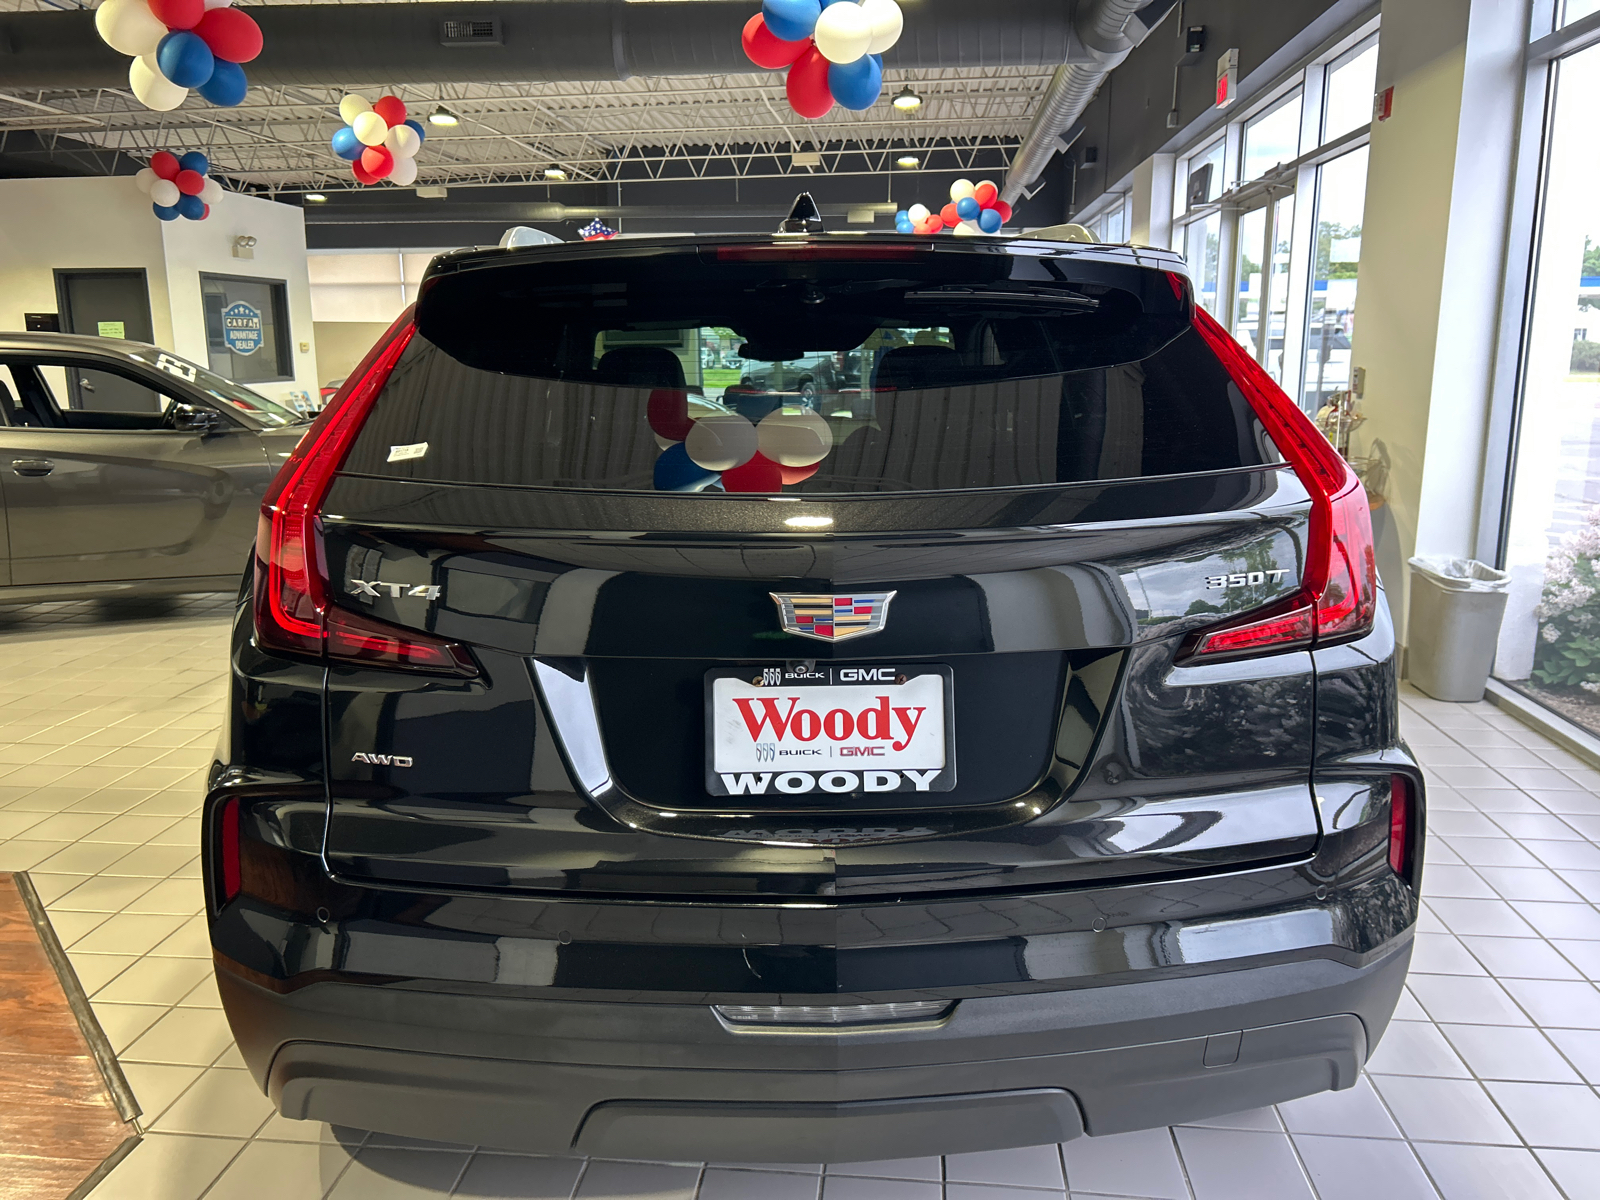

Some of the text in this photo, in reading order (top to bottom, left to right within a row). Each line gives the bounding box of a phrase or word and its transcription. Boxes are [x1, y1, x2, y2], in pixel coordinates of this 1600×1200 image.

[226, 318, 260, 329] CARFAX
[230, 330, 259, 340] ADVANTAGE
[235, 340, 255, 350] DEALER
[1205, 568, 1291, 590] 350T
[350, 579, 441, 600] XT4
[840, 668, 896, 681] GMC
[732, 696, 926, 752] Woody
[839, 745, 886, 757] GMC
[351, 752, 413, 767] AWD
[720, 770, 942, 795] WOODY
